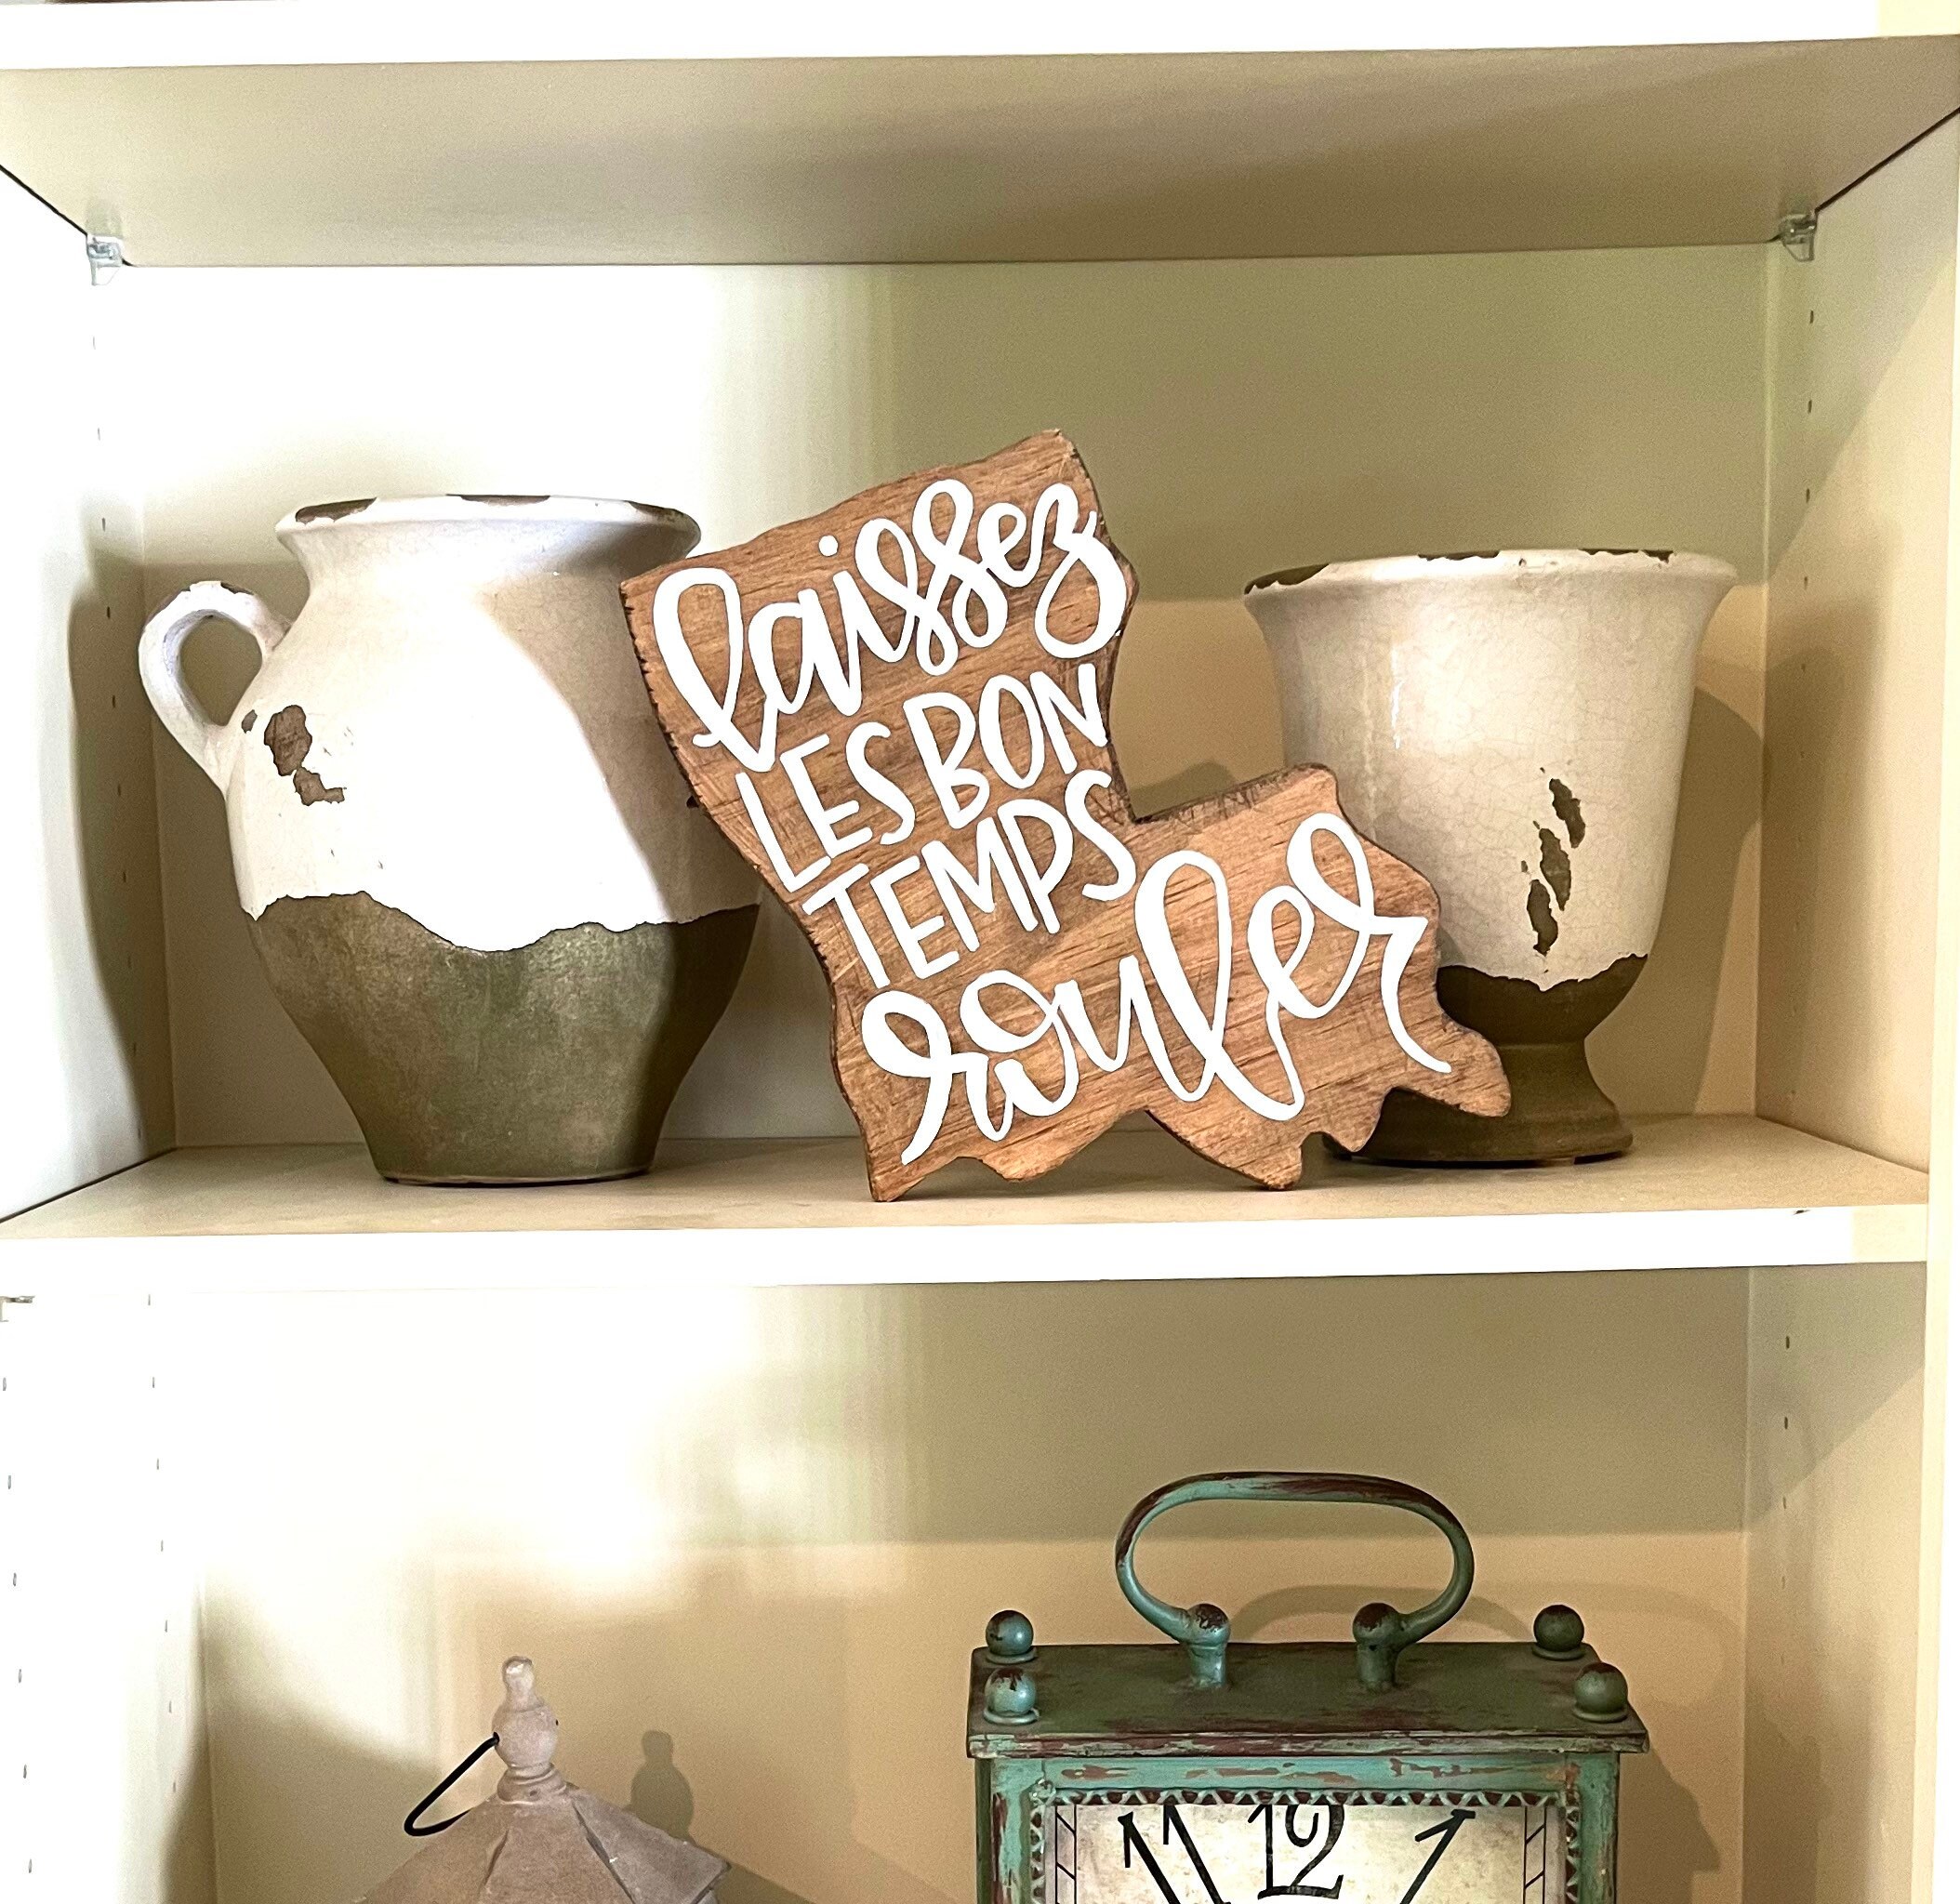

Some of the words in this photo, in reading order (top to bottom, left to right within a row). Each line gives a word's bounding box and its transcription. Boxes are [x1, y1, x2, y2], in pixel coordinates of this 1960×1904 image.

[654, 480, 1126, 772] laissez
[735, 722, 915, 892] LES
[904, 664, 1107, 828] BON
[802, 770, 1135, 988] TEMPS
[862, 813, 1450, 1164] rouler
[1248, 1803, 1344, 1899] 12
[1400, 1809, 1476, 1904] 1
